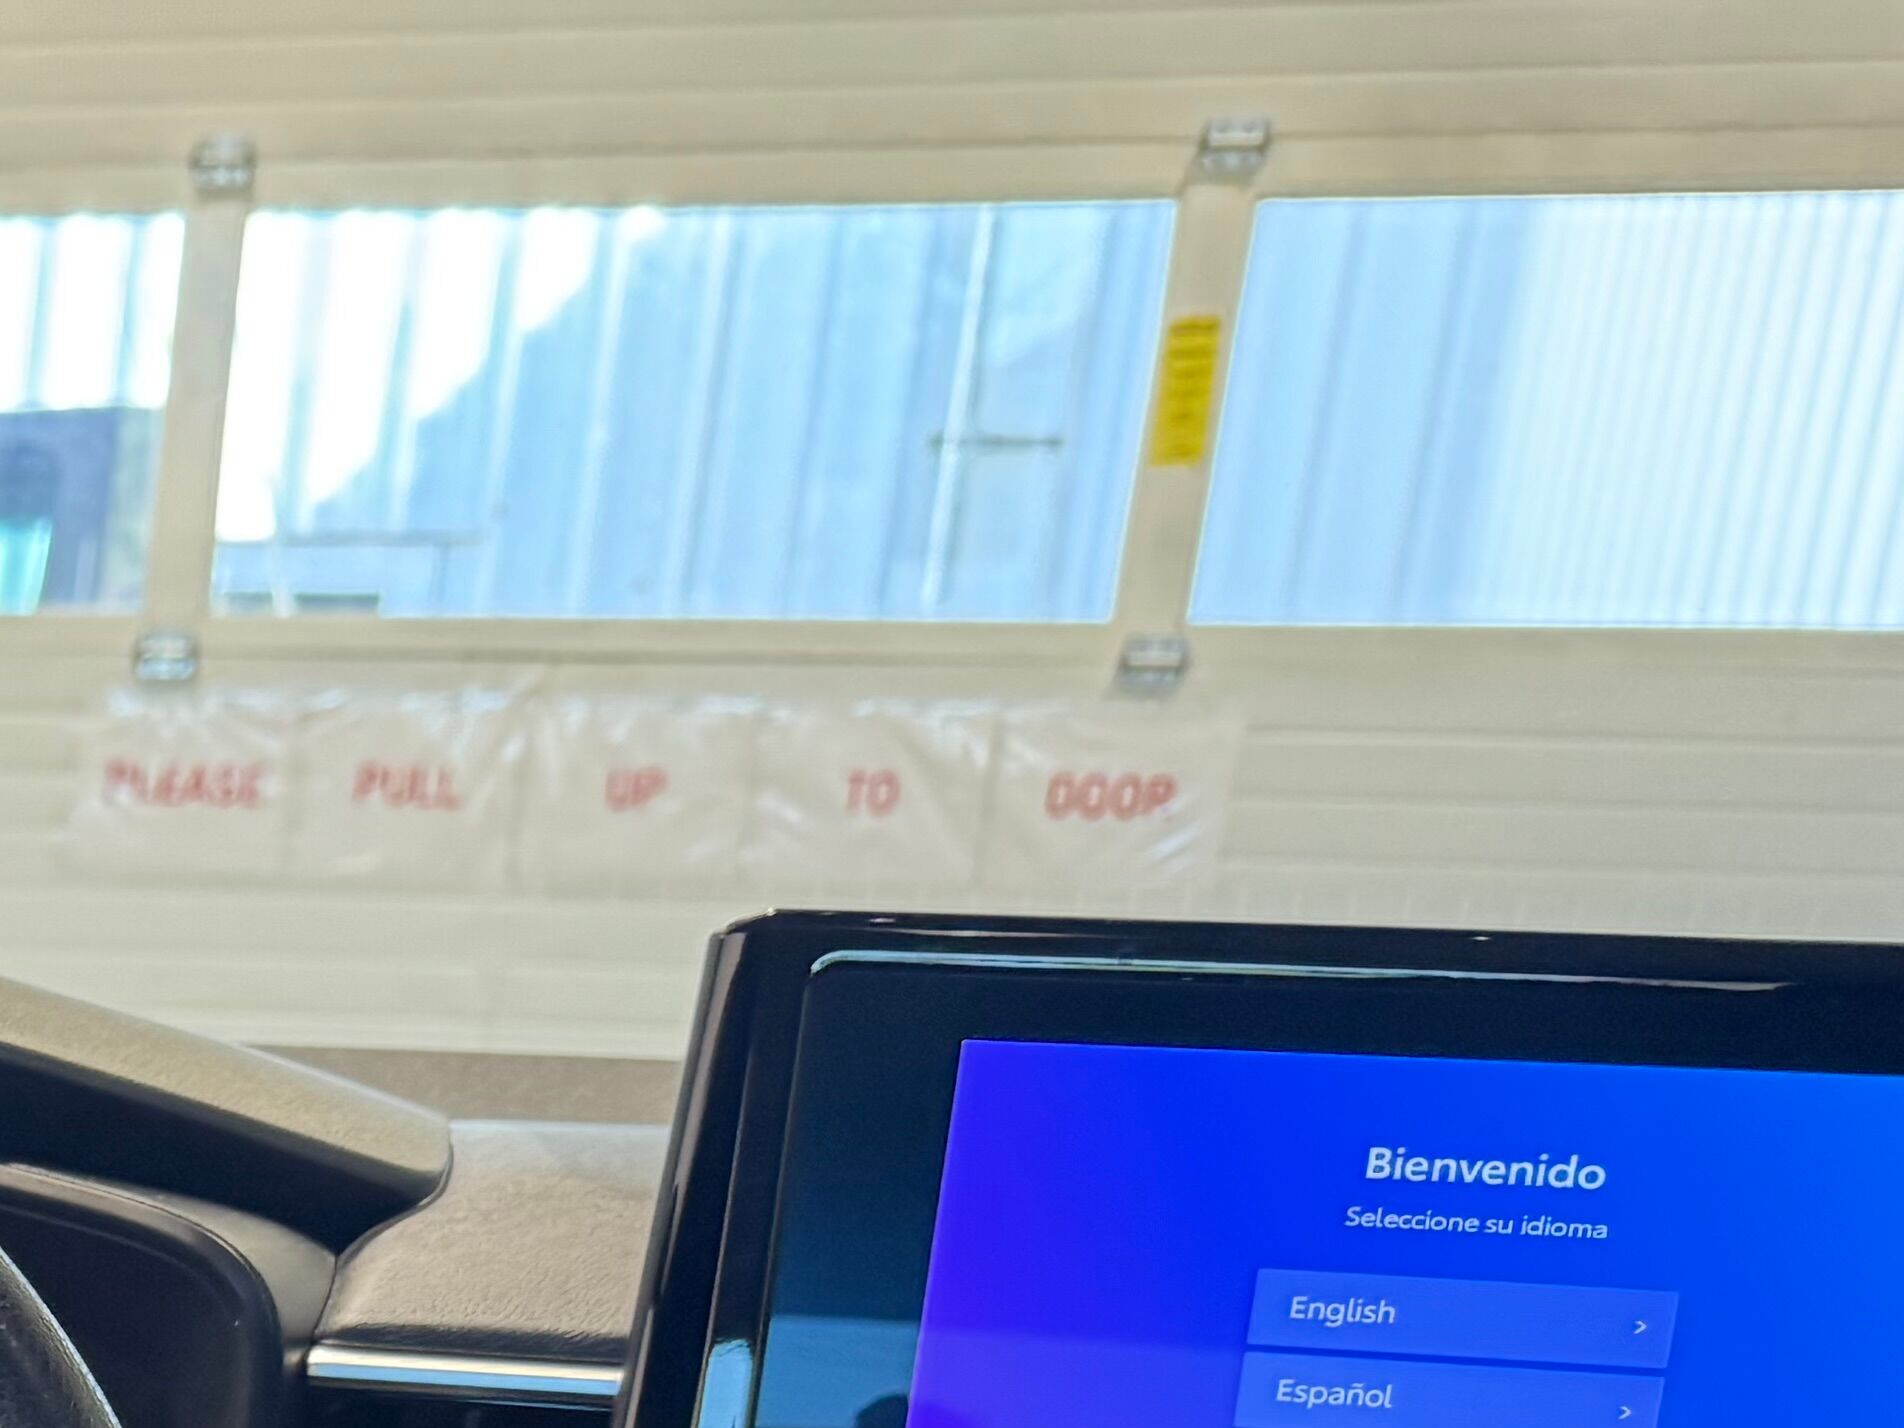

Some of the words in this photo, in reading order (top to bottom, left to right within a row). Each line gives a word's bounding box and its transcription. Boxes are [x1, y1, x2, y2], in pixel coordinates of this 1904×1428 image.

[354, 758, 462, 811] PULL
[604, 767, 667, 813] UP
[847, 769, 901, 818] TO
[1365, 1147, 1606, 1190] Bienvenido
[1344, 1206, 1480, 1233] Seleccione
[1484, 1217, 1513, 1235] su
[1520, 1215, 1608, 1239] idioma
[1289, 1296, 1397, 1328] English
[1276, 1379, 1393, 1409] Español
